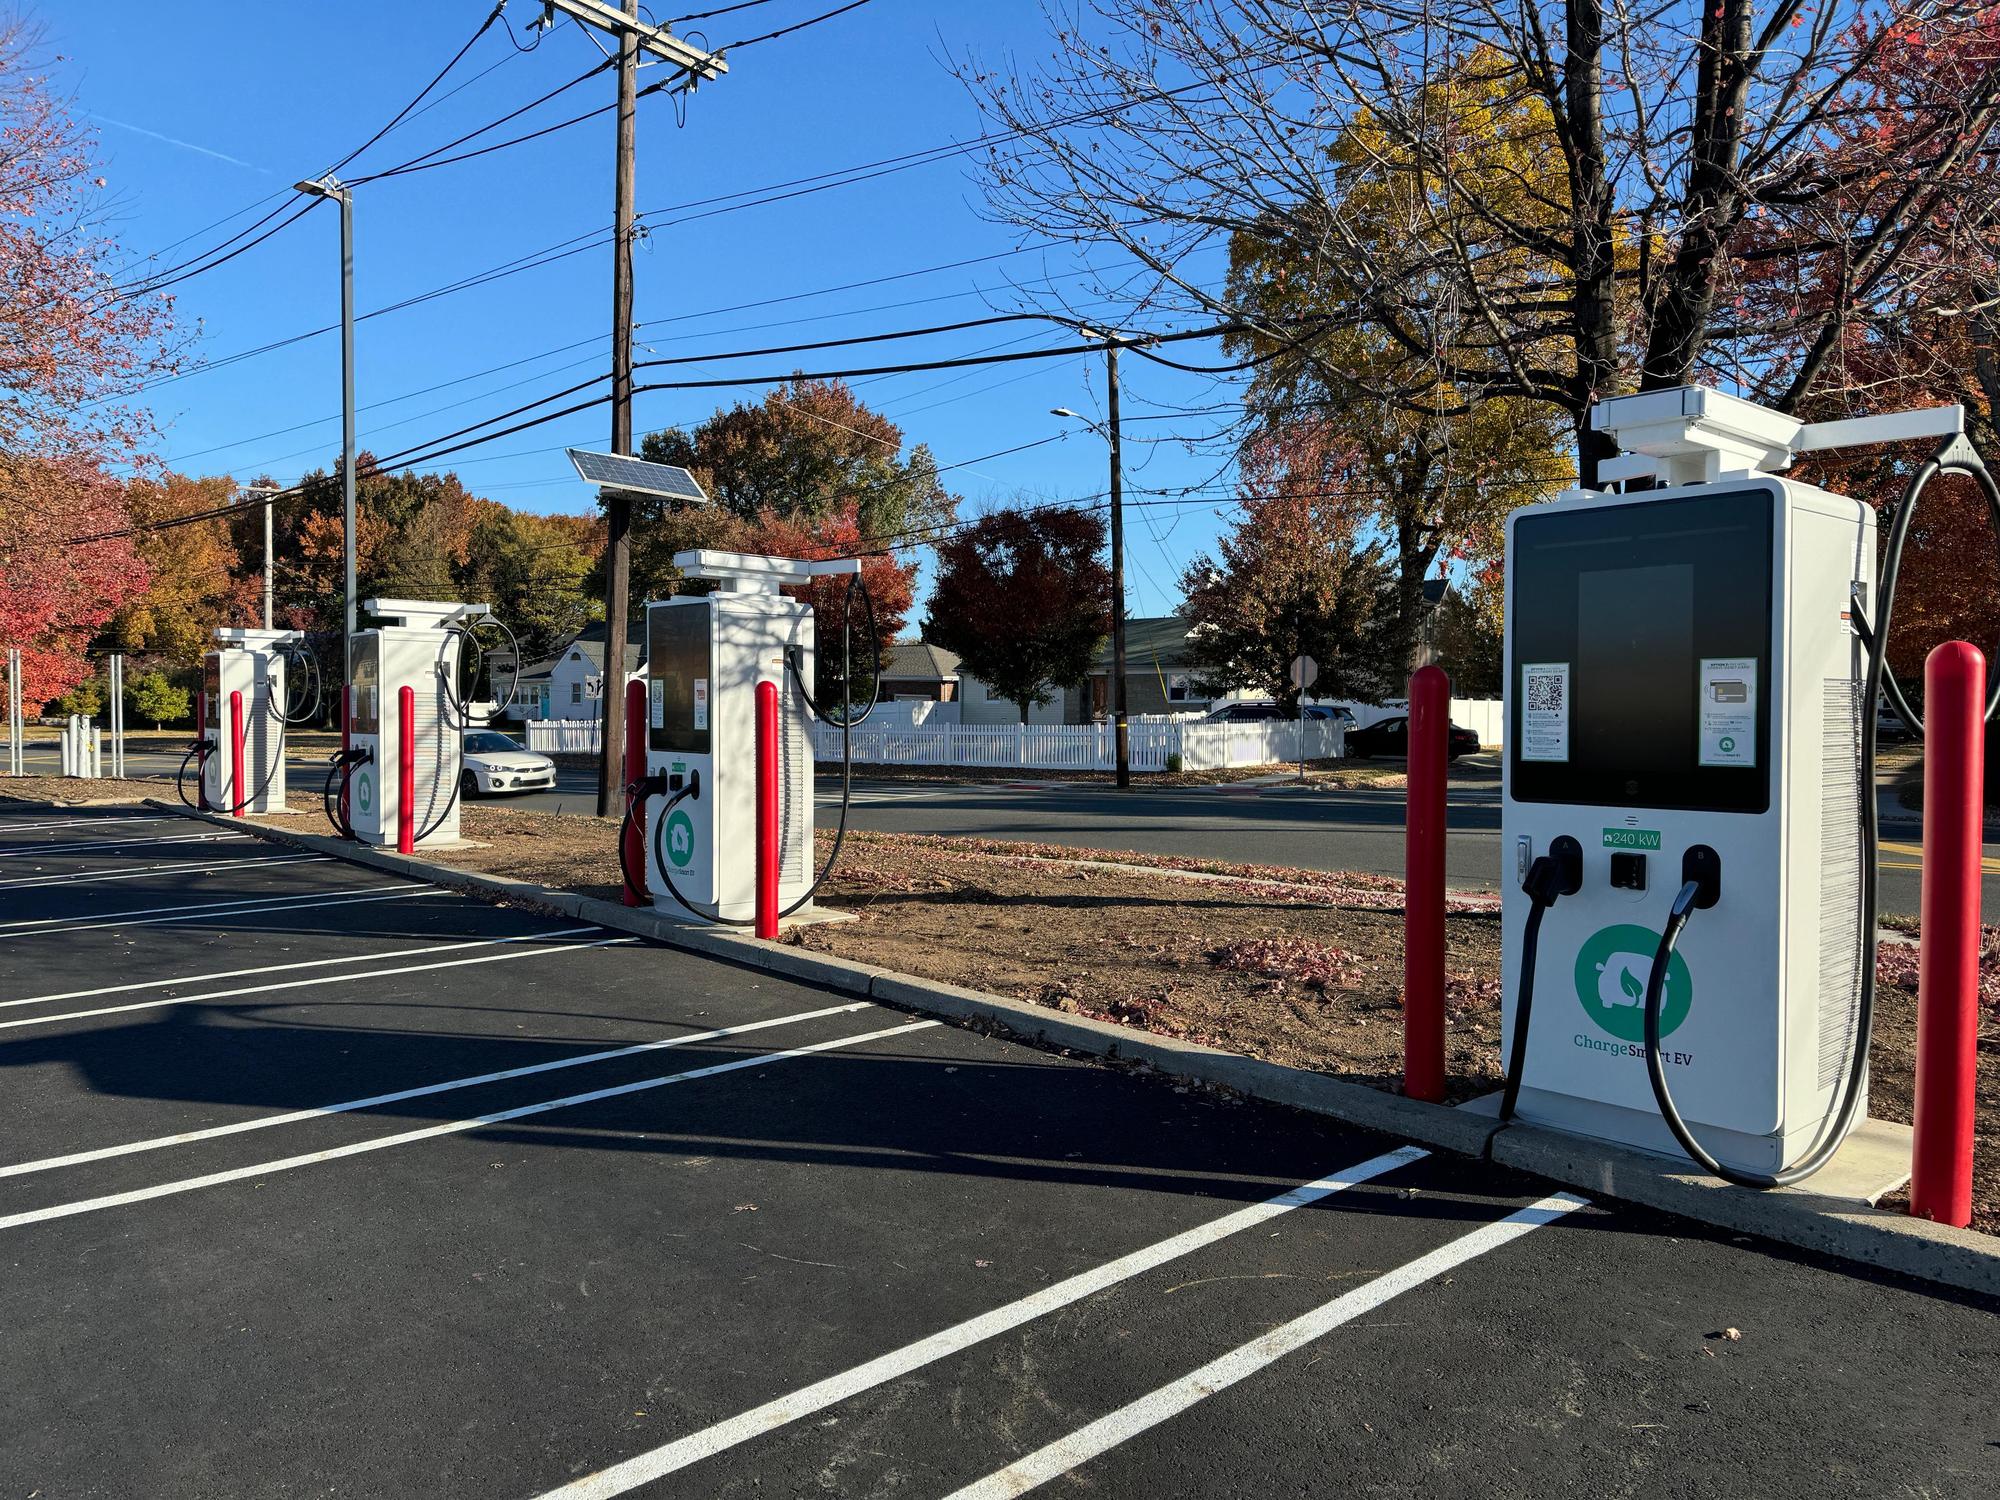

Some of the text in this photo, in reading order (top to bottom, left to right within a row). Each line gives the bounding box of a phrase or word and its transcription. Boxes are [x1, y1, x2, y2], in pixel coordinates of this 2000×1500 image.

[1613, 832, 1660, 846] 240 kW
[1562, 841, 1569, 849] A
[1697, 851, 1704, 860] B
[1573, 1034, 1693, 1066] ChargeSmrt EV
